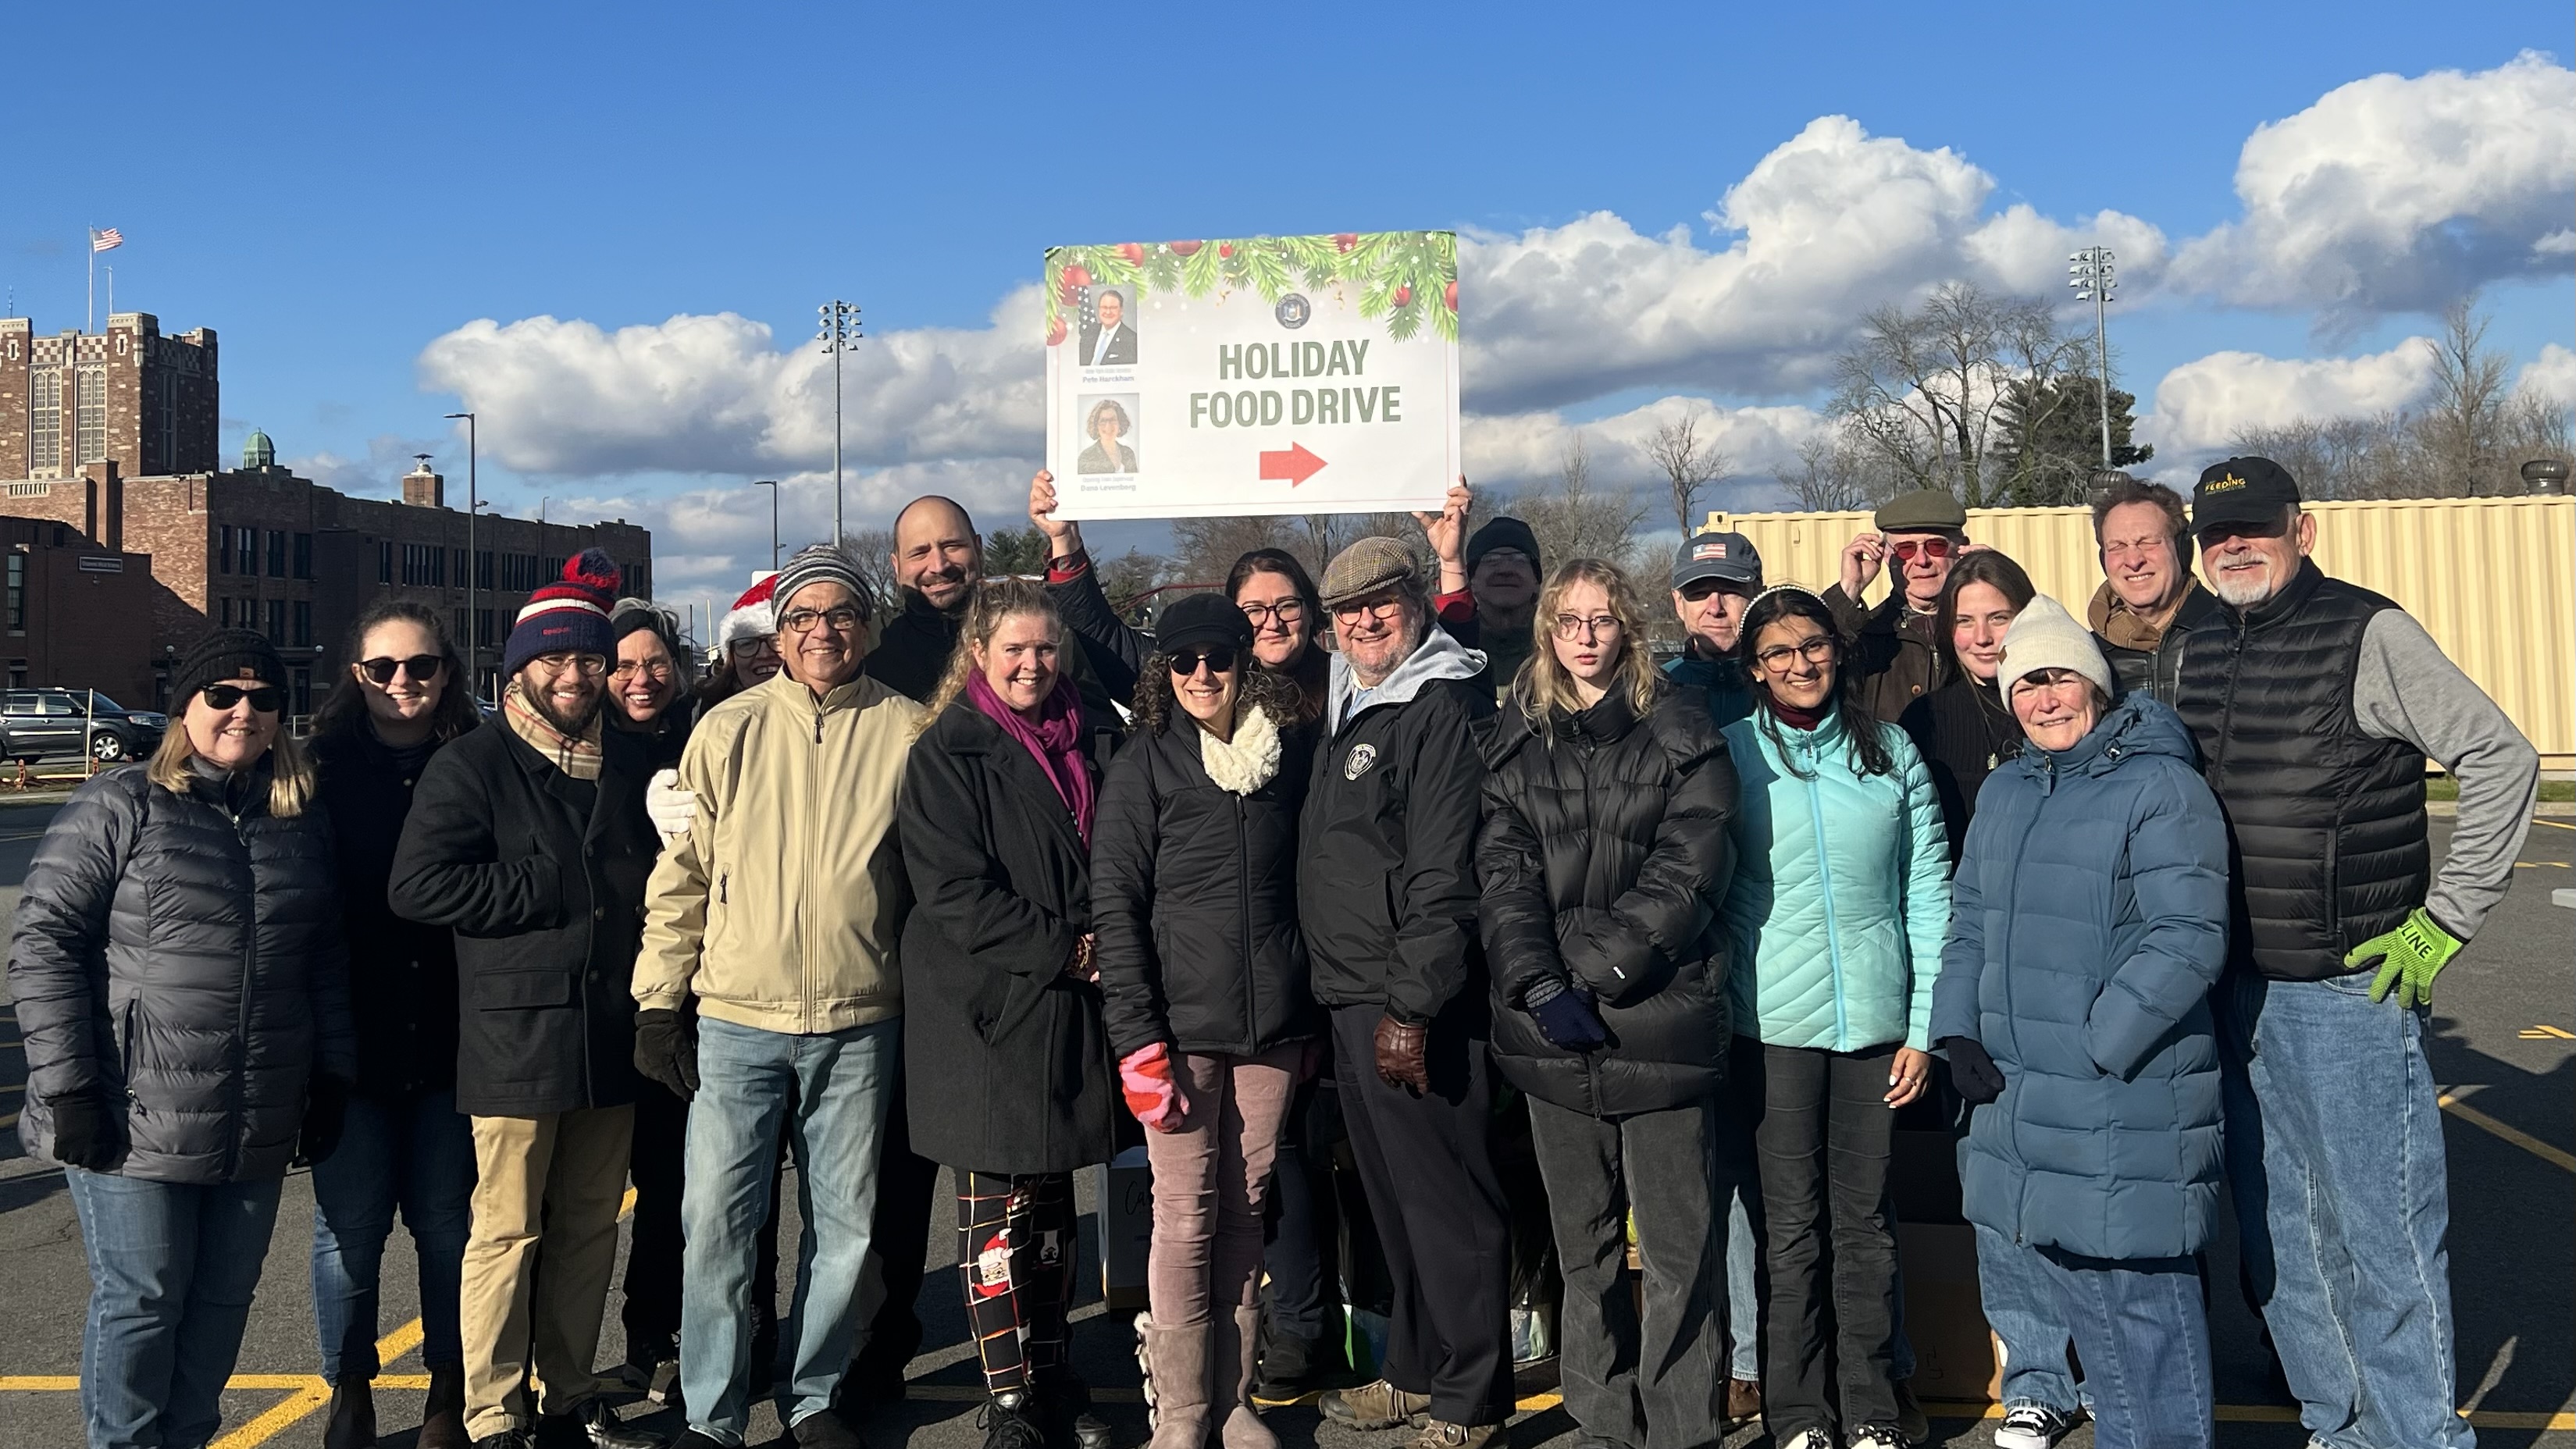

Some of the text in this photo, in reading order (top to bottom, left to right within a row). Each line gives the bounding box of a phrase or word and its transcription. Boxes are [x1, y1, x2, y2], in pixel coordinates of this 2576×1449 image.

[1220, 340, 1370, 380] HOLIDAY
[1191, 386, 1402, 429] FOOD DRIVE
[2205, 476, 2246, 492] FEEDING
